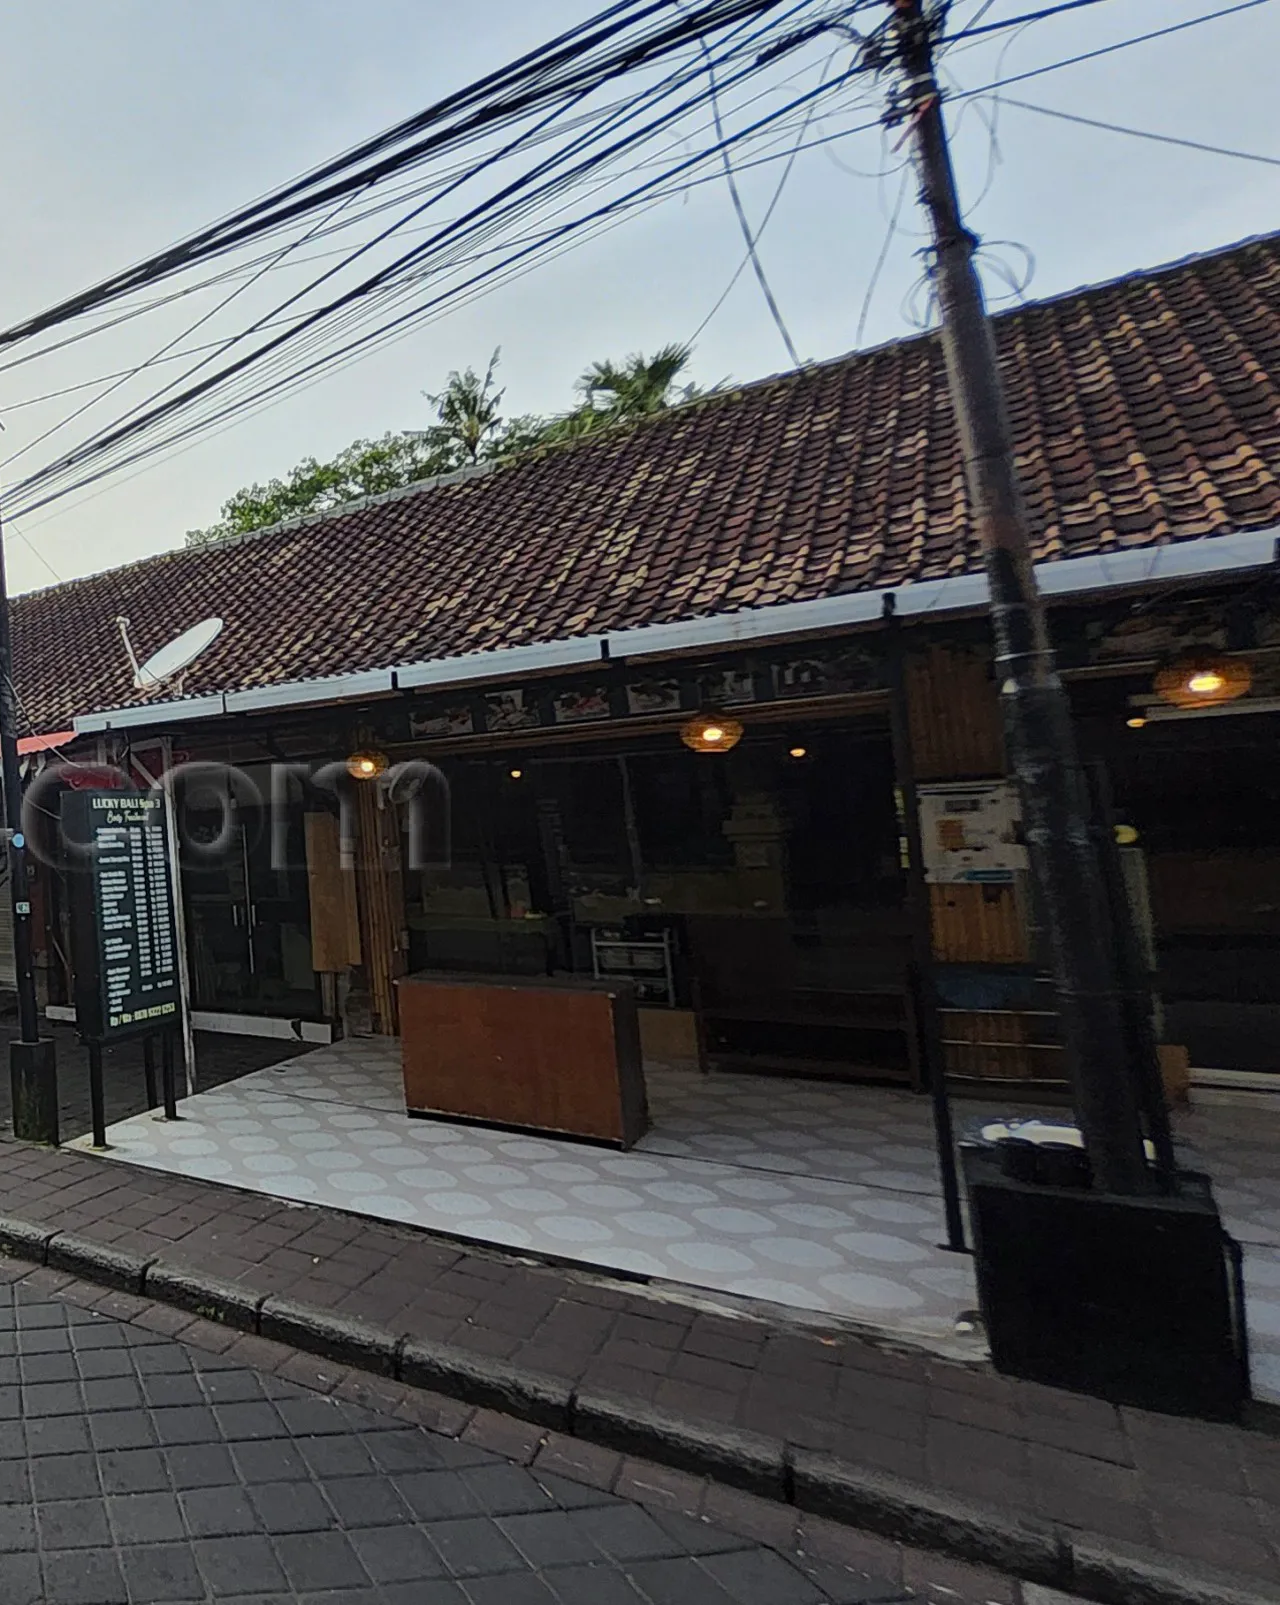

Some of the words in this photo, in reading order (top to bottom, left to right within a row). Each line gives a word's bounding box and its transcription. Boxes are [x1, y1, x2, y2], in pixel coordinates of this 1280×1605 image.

[92, 798, 119, 809] LUCKY
[120, 798, 139, 809] BALI
[139, 798, 154, 810] Spa
[155, 798, 161, 809] 3
